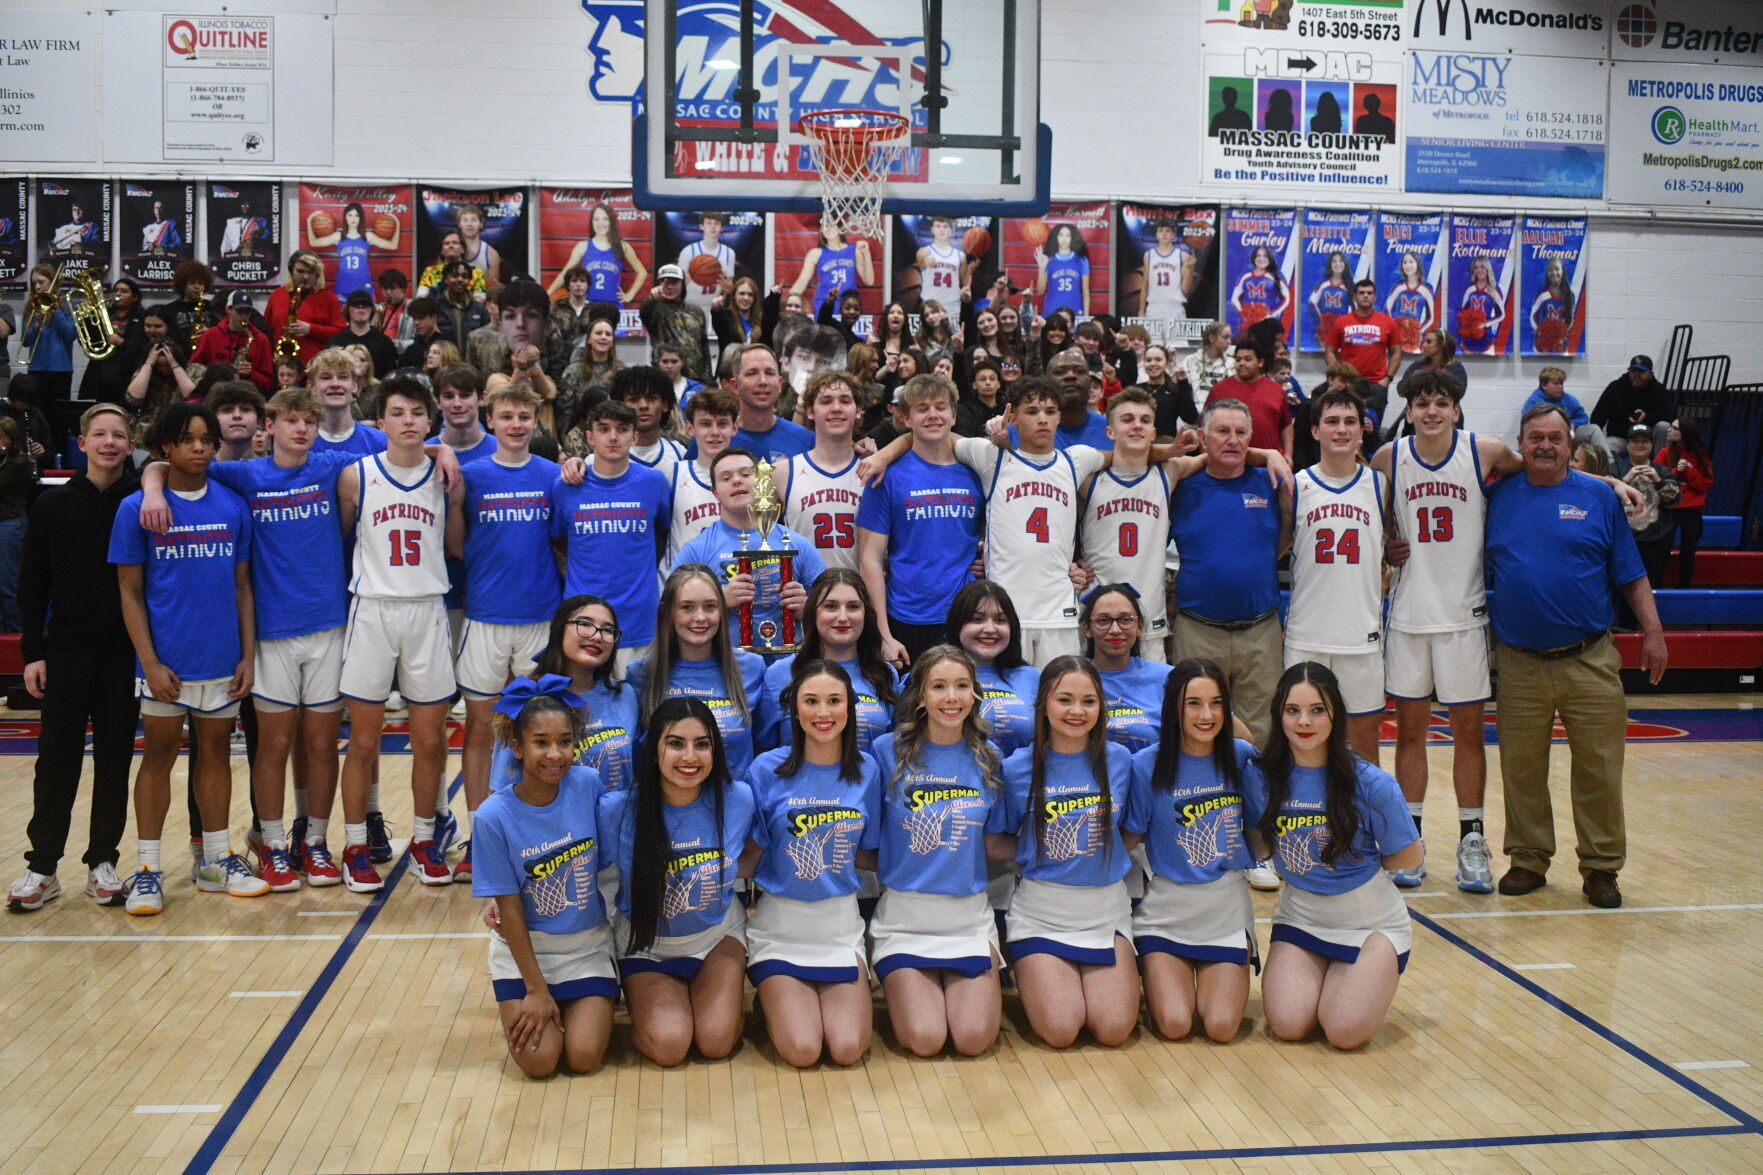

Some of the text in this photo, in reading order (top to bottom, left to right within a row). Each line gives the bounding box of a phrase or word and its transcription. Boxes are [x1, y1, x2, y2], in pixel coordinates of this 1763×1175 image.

[1302, 8, 1398, 22] 1407 East 5th Street
[1474, 8, 1603, 32] McDonald's
[199, 20, 268, 30] ILLINOIS TOBACCO
[12, 40, 80, 51] LAW FIRM
[168, 19, 268, 55] QUITLINE
[7, 55, 31, 66] Law
[1411, 53, 1512, 93] MISTY
[1411, 87, 1507, 107] MEADOWS
[1628, 79, 1763, 103] METROPOLIS DRUGS
[1432, 109, 1441, 119] of
[1505, 110, 1603, 125] tel 618.524.1818
[1219, 130, 1387, 151] MASSAC COUNTY
[1502, 127, 1603, 141] fax 618.524.1718
[1421, 138, 1526, 150] SENIOR LIVING CENTER
[1223, 147, 1380, 163] Drug Awareness Coalition
[1247, 160, 1357, 171] Youth Advisory Council
[1214, 168, 1389, 186] Be the Positive Influence!
[1664, 179, 1744, 194] 618-524-8400
[1227, 218, 1293, 233] SUMMER 23-24
[1383, 224, 1440, 241] MACI 23-24
[1241, 230, 1287, 253] Gurley
[1455, 227, 1487, 245] ELLIE
[1532, 244, 1579, 261] Thomas
[65, 259, 89, 269] JAKE
[147, 260, 171, 270] ALEX
[231, 261, 262, 271] CHRIS
[346, 256, 360, 270] 13
[227, 270, 268, 281] PUCKETT
[594, 272, 605, 290] 2
[831, 269, 847, 284] 34
[933, 272, 953, 288] 24
[1156, 273, 1170, 287] 13
[1057, 278, 1073, 292] 35
[1246, 283, 1267, 299] M
[1323, 291, 1342, 308] M
[1401, 296, 1418, 313] M
[1470, 295, 1487, 312] M
[1343, 324, 1381, 337] PATRIOTS
[256, 484, 320, 497] MASSAC COUNTY
[483, 492, 514, 500] MASSAC
[910, 489, 941, 497] MASSAC
[1005, 481, 1069, 508] PATRIOTS
[1405, 481, 1467, 502] PATRIOTS
[251, 490, 330, 523] PATRIOTS
[372, 502, 435, 527] PATRIOTS
[478, 498, 550, 523] PATRIOTS
[904, 496, 976, 521] PATRIOTS
[1097, 497, 1160, 521] PATRIOTS
[1306, 503, 1370, 527] PATRIOTS
[196, 523, 228, 531] COUNTY
[574, 509, 648, 535] PATRIOTS
[813, 512, 855, 549] 25
[1025, 506, 1050, 543] 4
[1416, 506, 1453, 543] 13
[154, 530, 234, 560] PATRIOTS
[388, 529, 422, 567] 15
[1118, 522, 1139, 557] 0
[1315, 528, 1361, 565] 24
[683, 687, 715, 695] Annual
[926, 773, 958, 783] Annual
[1058, 783, 1090, 793] Annual
[1172, 782, 1224, 797] 40th Annual
[787, 796, 841, 806] 40th Annual
[912, 789, 980, 813] SUPERMAN
[1290, 800, 1322, 809] Annual
[795, 810, 862, 838] SUPERMAN
[520, 832, 573, 858] 40th Annual
[533, 839, 595, 882] SUPERMAN
